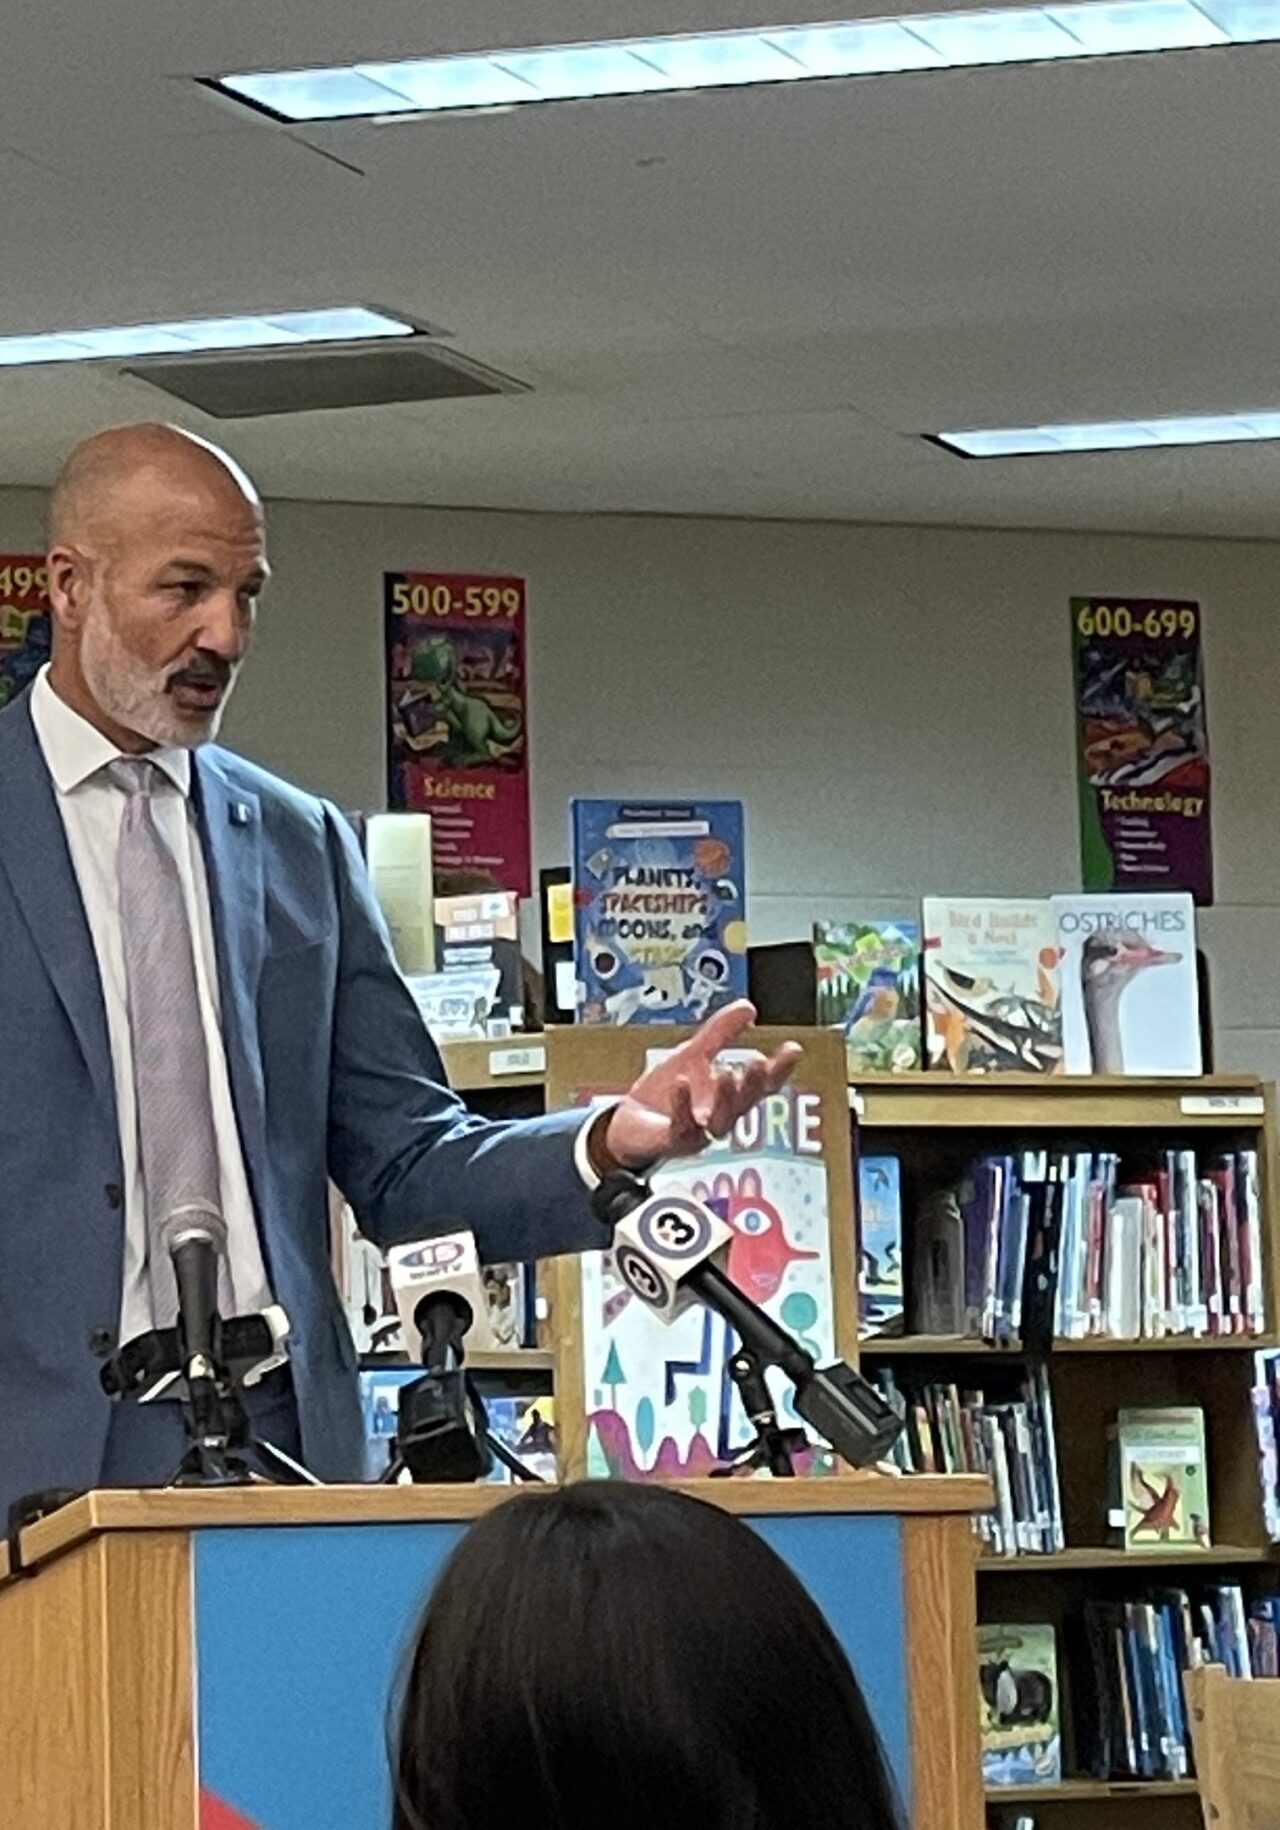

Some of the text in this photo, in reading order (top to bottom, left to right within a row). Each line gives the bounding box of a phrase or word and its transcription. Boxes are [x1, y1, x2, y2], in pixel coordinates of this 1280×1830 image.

[391, 583, 520, 617] 500-599
[1076, 606, 1196, 639] 600-699
[423, 776, 496, 800] Science
[1100, 789, 1204, 818] Technology
[1059, 910, 1186, 933] OSTRICHES
[656, 1211, 696, 1246] 3
